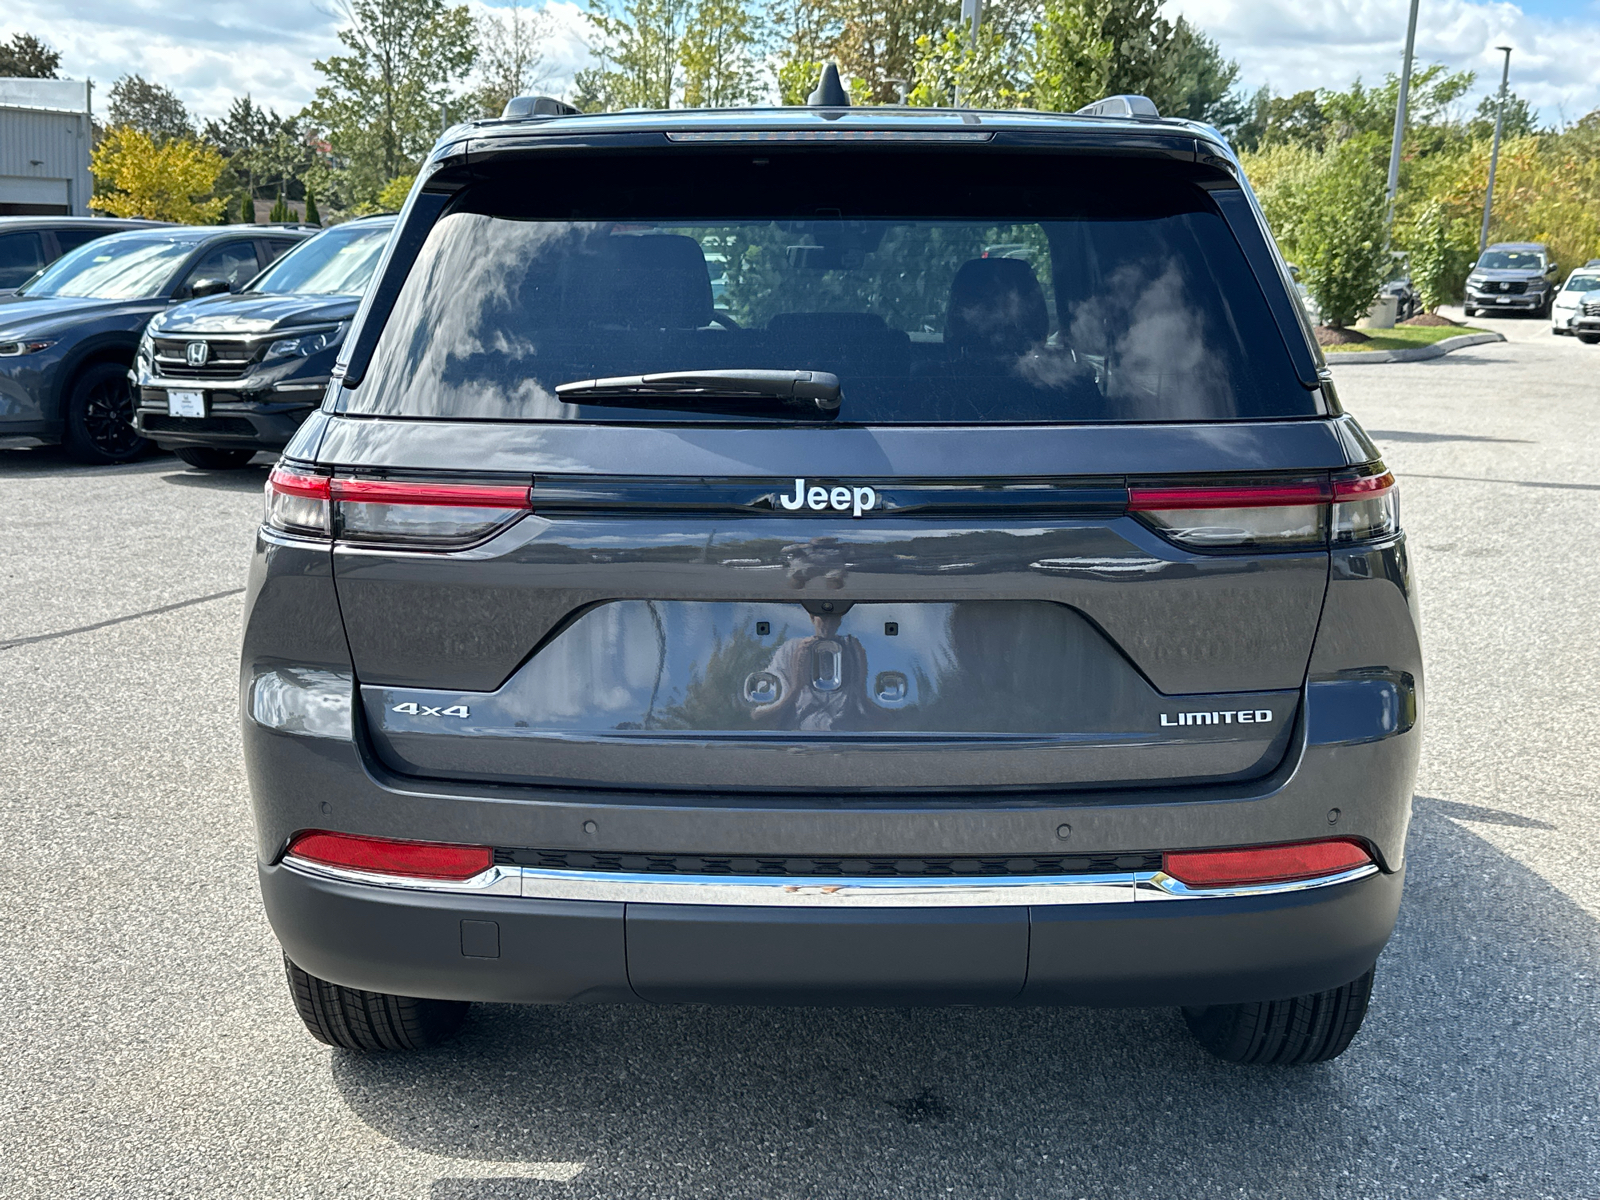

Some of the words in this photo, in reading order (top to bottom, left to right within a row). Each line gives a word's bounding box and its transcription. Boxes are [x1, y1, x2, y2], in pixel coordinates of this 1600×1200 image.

[780, 478, 876, 517] Jeep
[391, 702, 471, 719] 4x4
[1160, 709, 1273, 727] LIMITED
